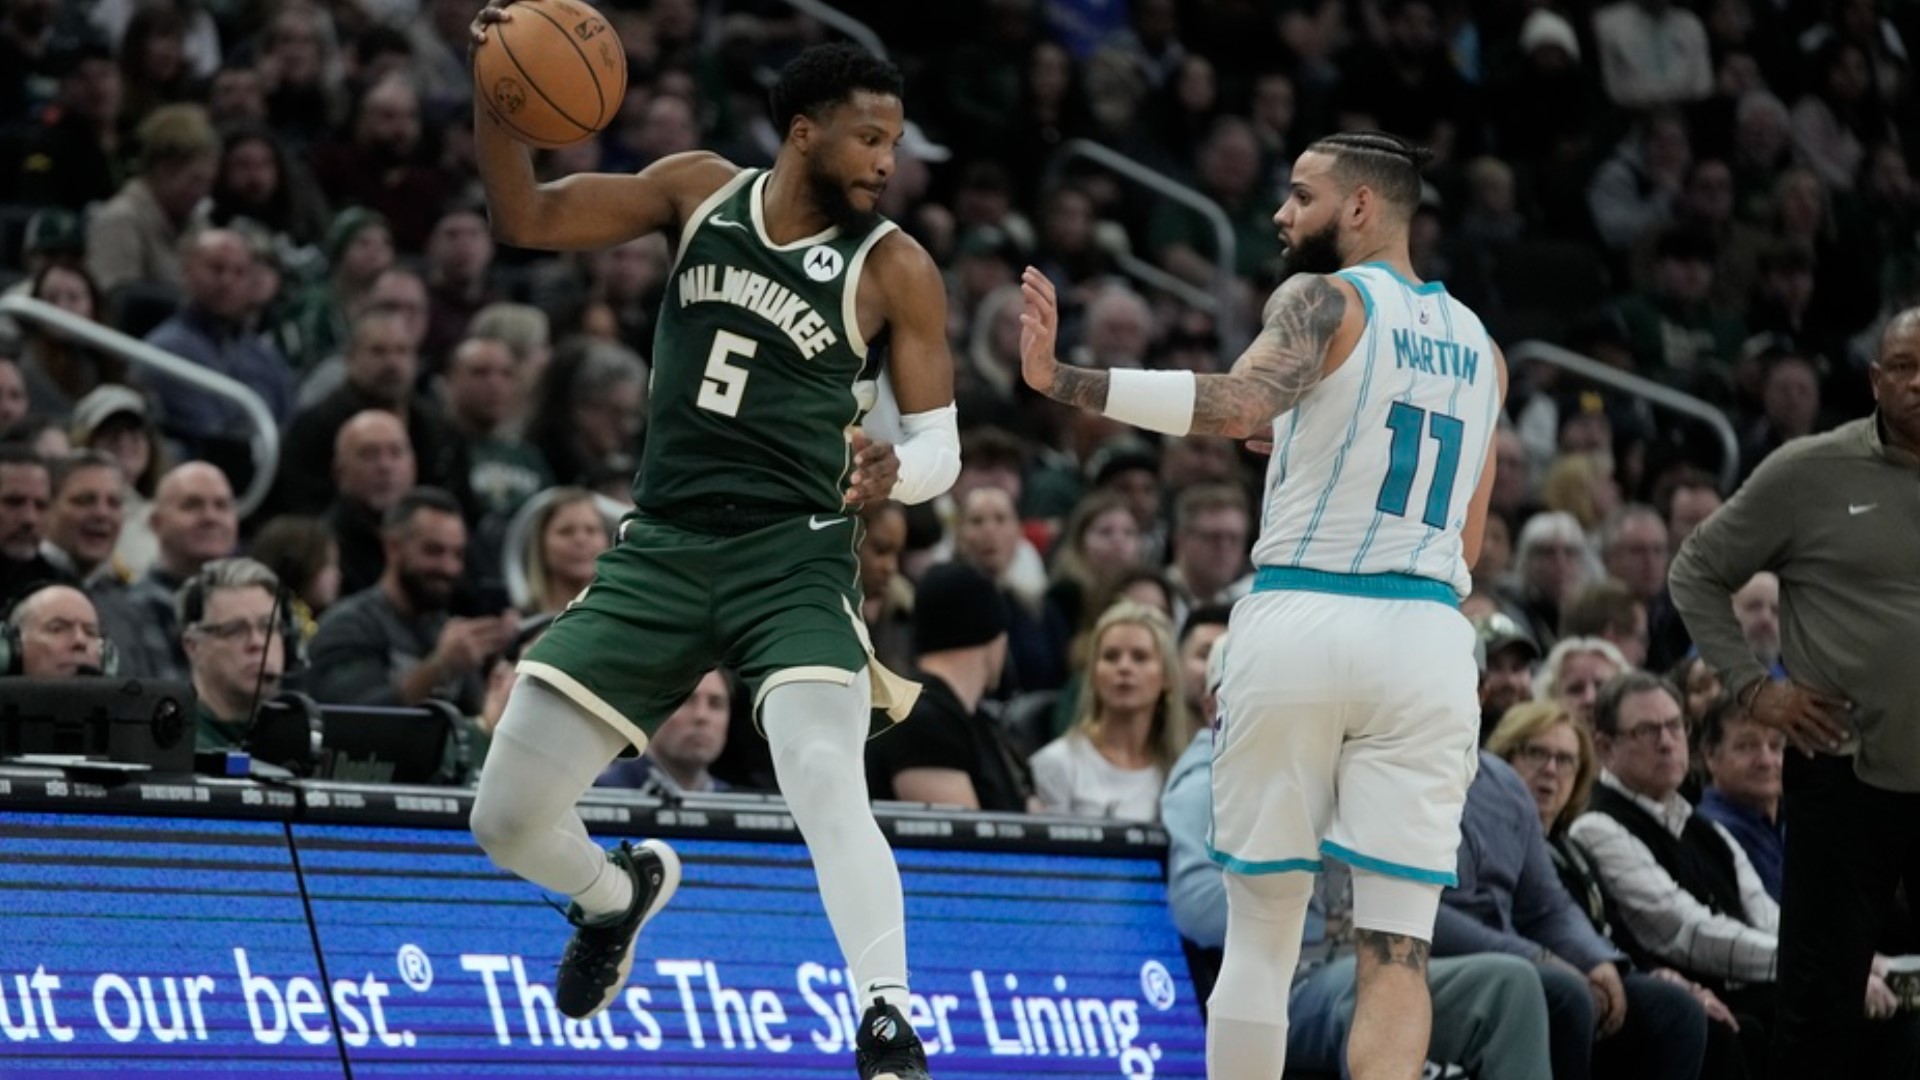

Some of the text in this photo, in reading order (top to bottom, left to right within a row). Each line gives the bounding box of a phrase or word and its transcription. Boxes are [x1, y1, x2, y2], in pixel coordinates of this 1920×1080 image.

[679, 264, 839, 361] MILWAUKEE
[1391, 327, 1480, 387] MARTIN
[696, 329, 758, 418] 5
[1376, 400, 1465, 531] 11
[93, 973, 216, 1042] our
[460, 954, 662, 1050] Thas
[655, 959, 793, 1053] The
[797, 962, 958, 1055] Siler
